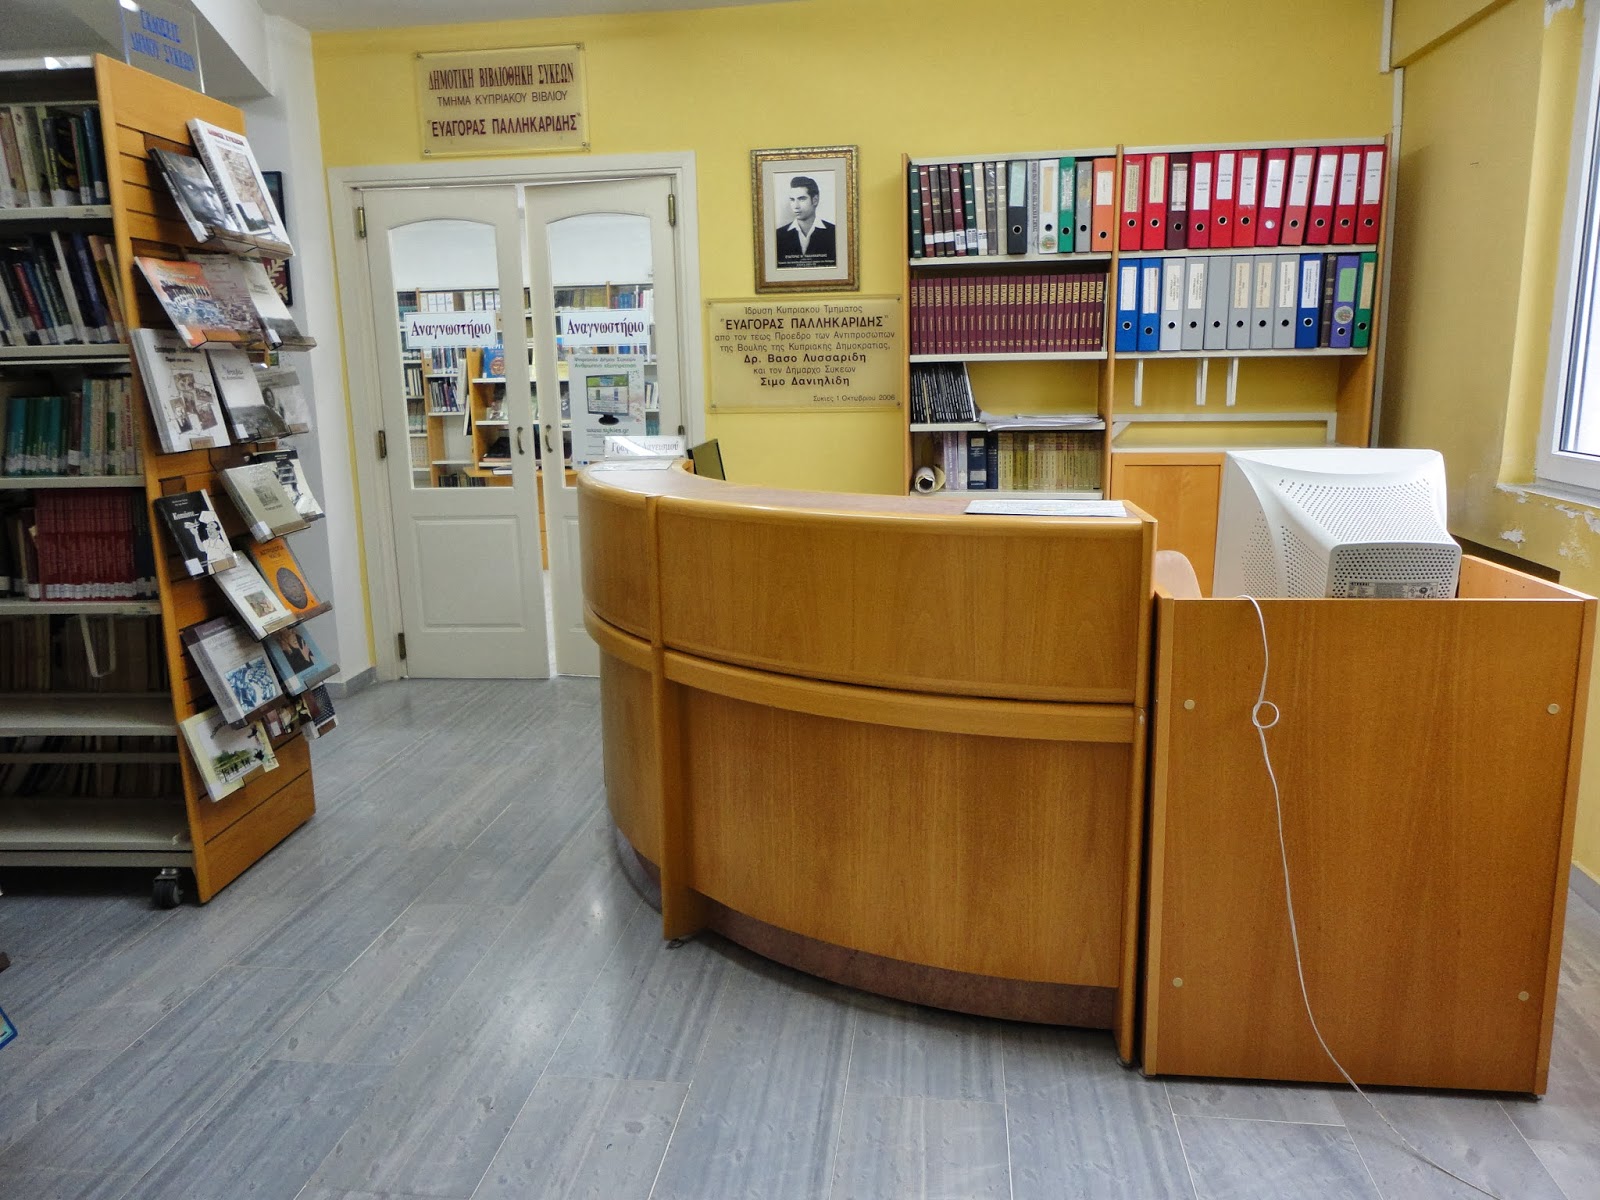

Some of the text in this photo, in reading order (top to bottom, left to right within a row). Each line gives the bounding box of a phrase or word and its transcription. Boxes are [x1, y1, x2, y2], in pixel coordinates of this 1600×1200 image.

[428, 62, 574, 90] ΔΗΜΟΤΙΚΗ ΒΙΒΛΙΟΘΗΚΗ ΣΥΚΕΩΝ
[437, 90, 568, 107] ΤΜΗΜΑ ΚΥΠΡΙΑΚΟΥ ΒΙΒΛΙΟΥ
[776, 306, 820, 315] Κυπριακου
[824, 305, 863, 313] Τμηματος
[411, 318, 491, 339] Αναγνωστήριο
[567, 317, 644, 338] Αναγνωστήριο
[775, 332, 811, 341] Προεδρο
[834, 331, 895, 339] Αντιπροσωπων
[738, 344, 767, 352] Βουλης
[789, 343, 832, 351] Κυπριακης
[744, 353, 866, 364] Δρ. Βασο Λυσσαριδη
[786, 366, 820, 375] Δημαρχο
[760, 376, 850, 387] Σιμο Δανιηλιδη
